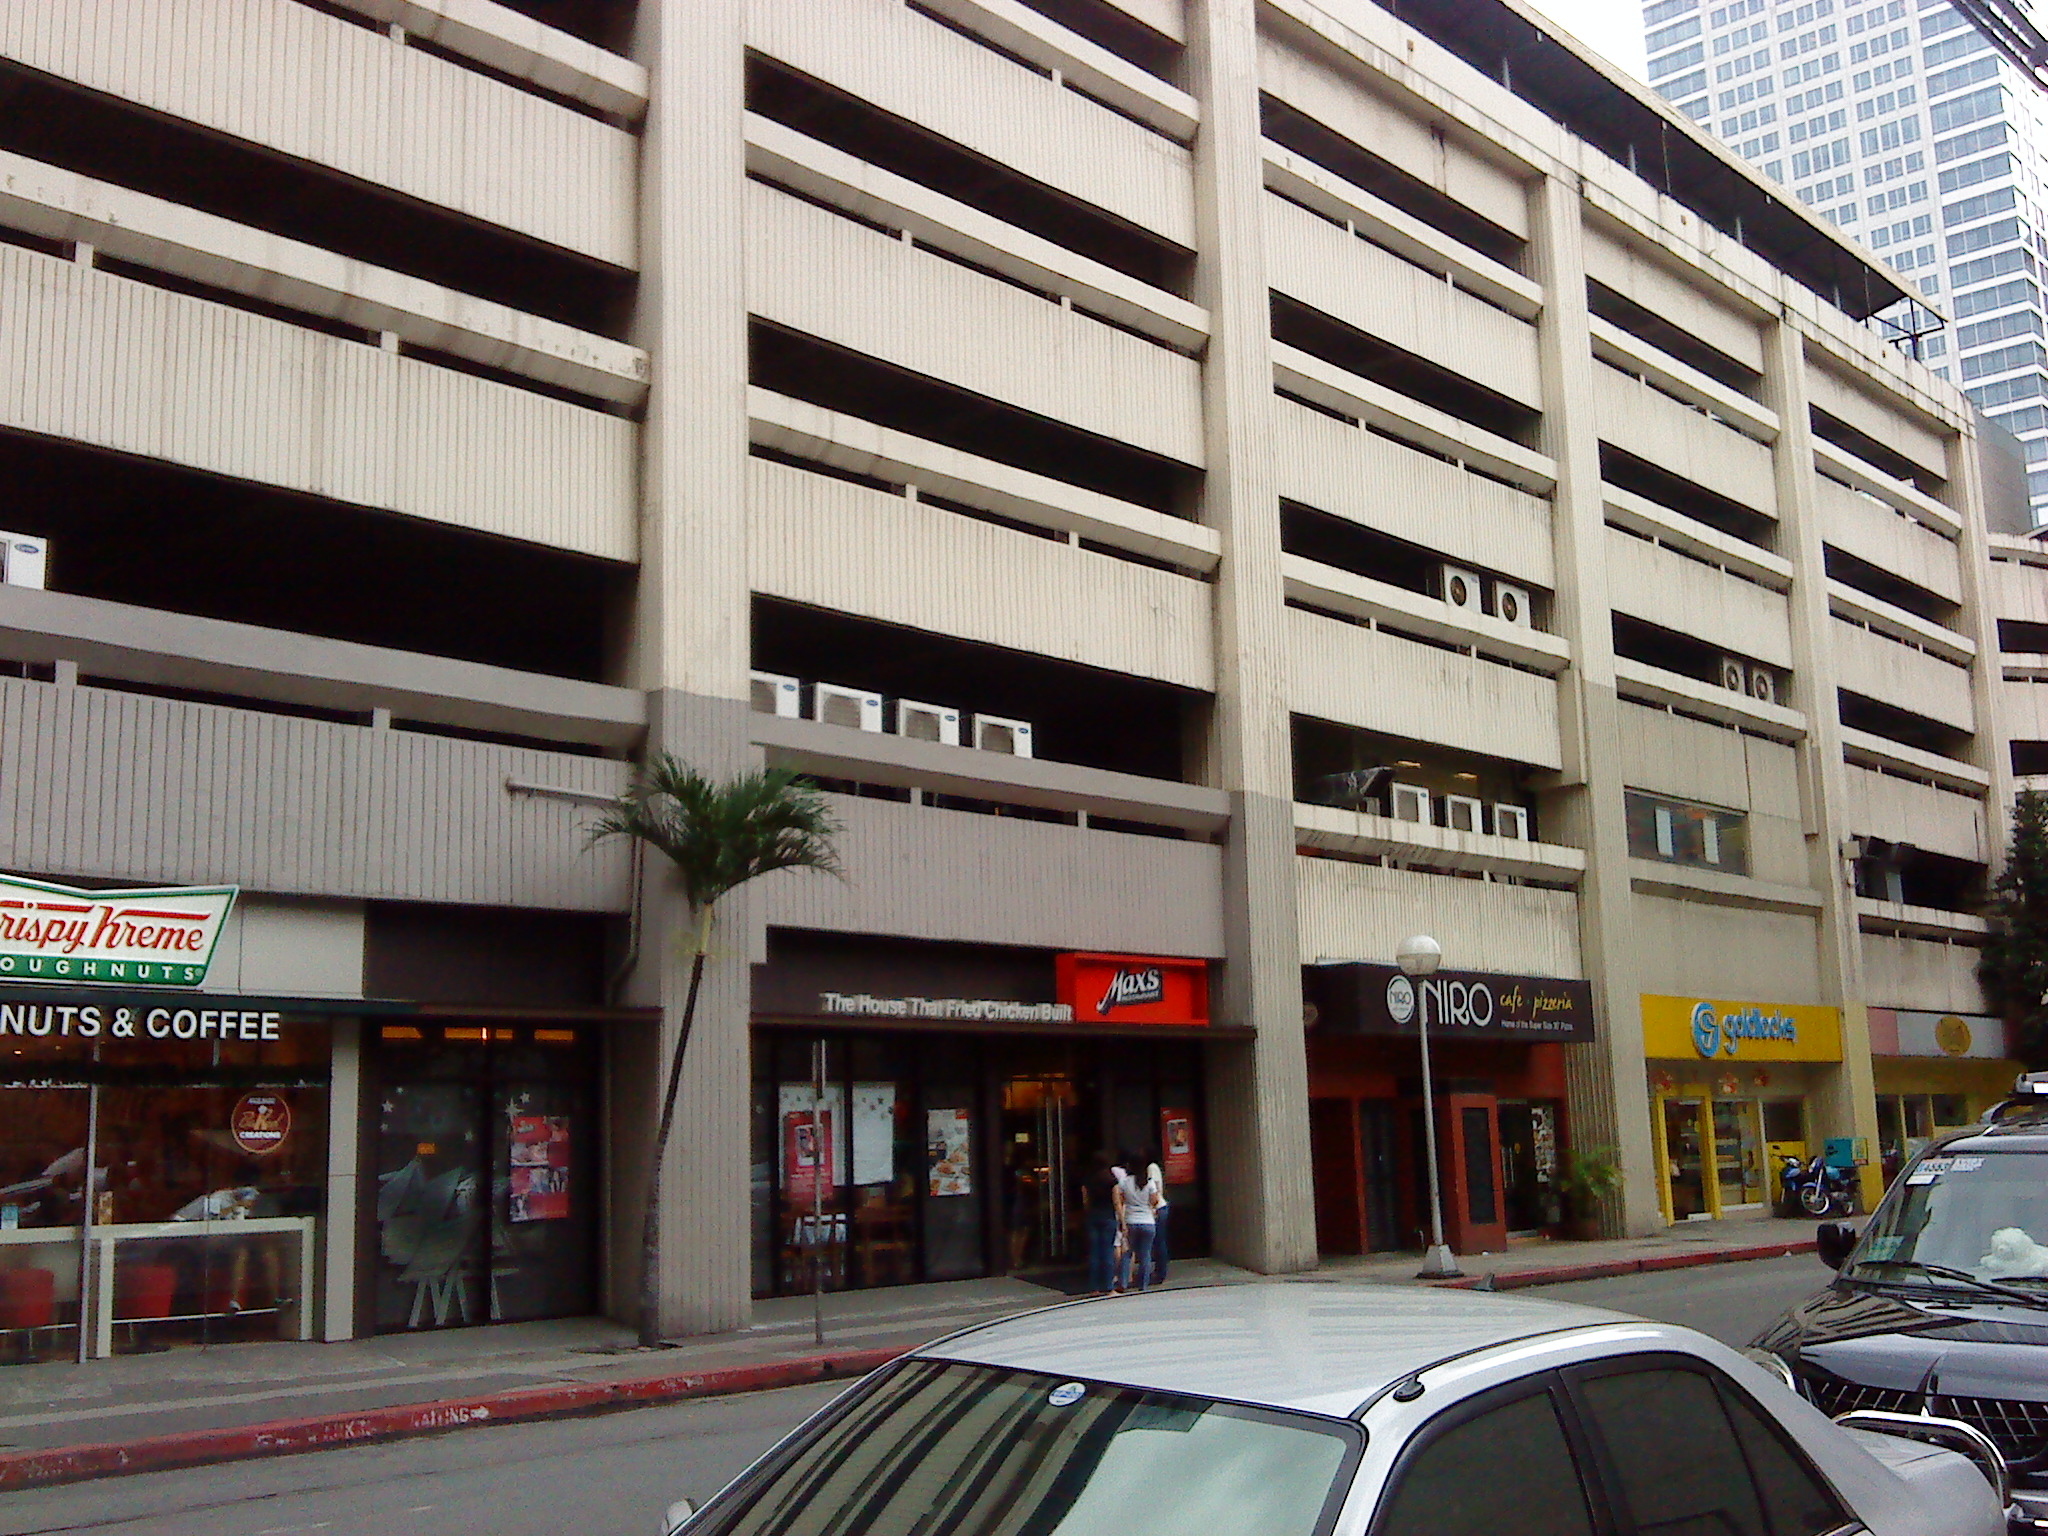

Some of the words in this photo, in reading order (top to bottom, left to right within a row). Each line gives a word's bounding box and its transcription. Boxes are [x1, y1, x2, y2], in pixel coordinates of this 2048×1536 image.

[0, 901, 94, 953] rispy
[89, 904, 211, 951] Kreme
[821, 992, 855, 1012] The
[857, 994, 907, 1014] House
[945, 999, 981, 1018] Fried
[983, 1000, 1038, 1020] Chicken
[1039, 1003, 1072, 1021] Built
[1422, 979, 1493, 1027] NIRO
[1500, 985, 1523, 1014] cafe
[1533, 990, 1573, 1018] pizzeria
[111, 1008, 135, 1038] &
[147, 1008, 280, 1039] COFFEE
